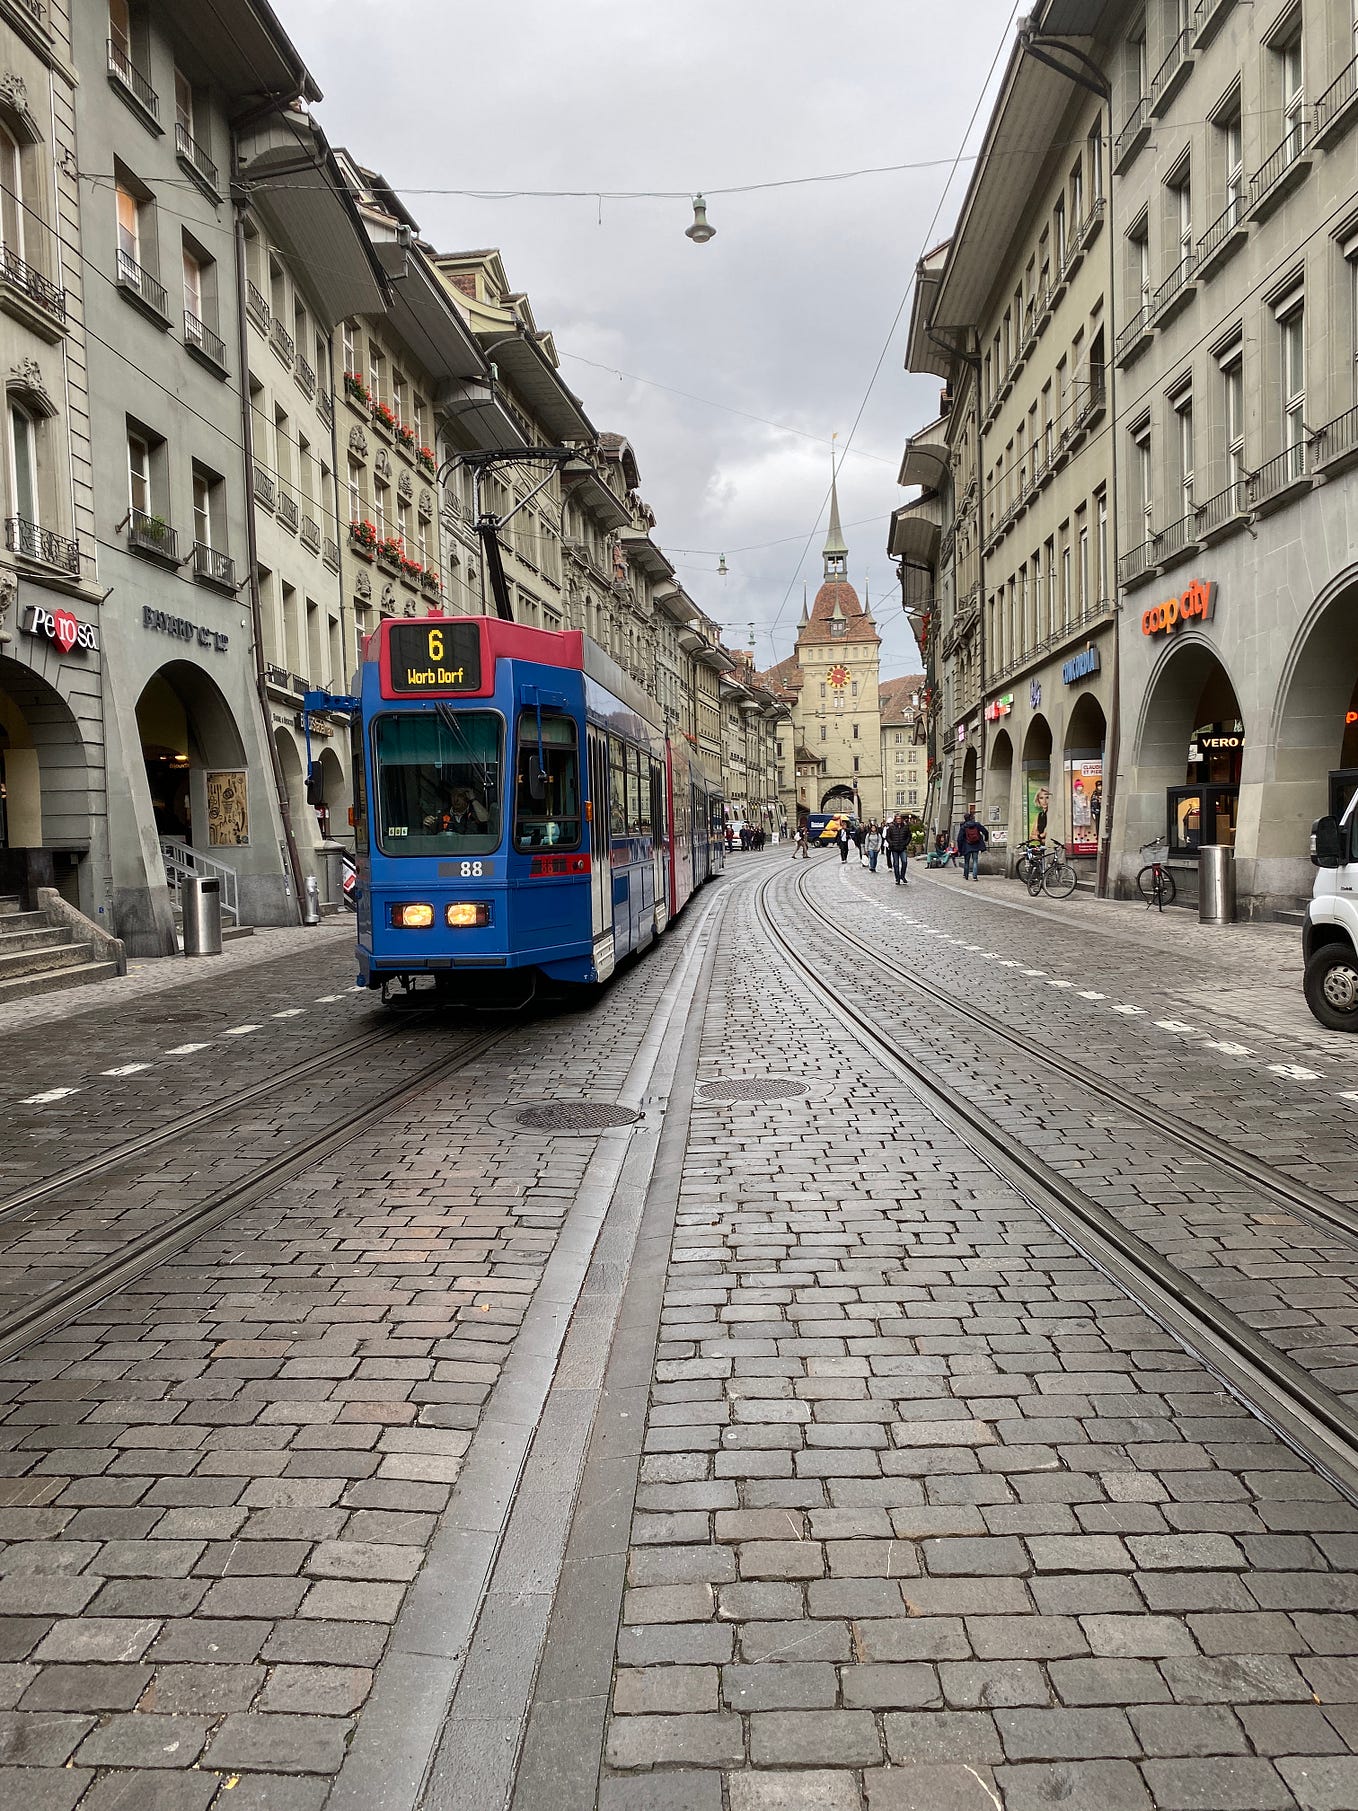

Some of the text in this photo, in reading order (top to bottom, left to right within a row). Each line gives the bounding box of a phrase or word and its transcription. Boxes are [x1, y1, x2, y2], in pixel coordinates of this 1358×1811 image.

[1142, 578, 1211, 636] coop city
[142, 605, 194, 640] BAYARD
[428, 629, 444, 661] 6
[407, 667, 464, 685] Worb Dorf
[1202, 737, 1239, 748] VERO
[460, 861, 483, 877] 88
